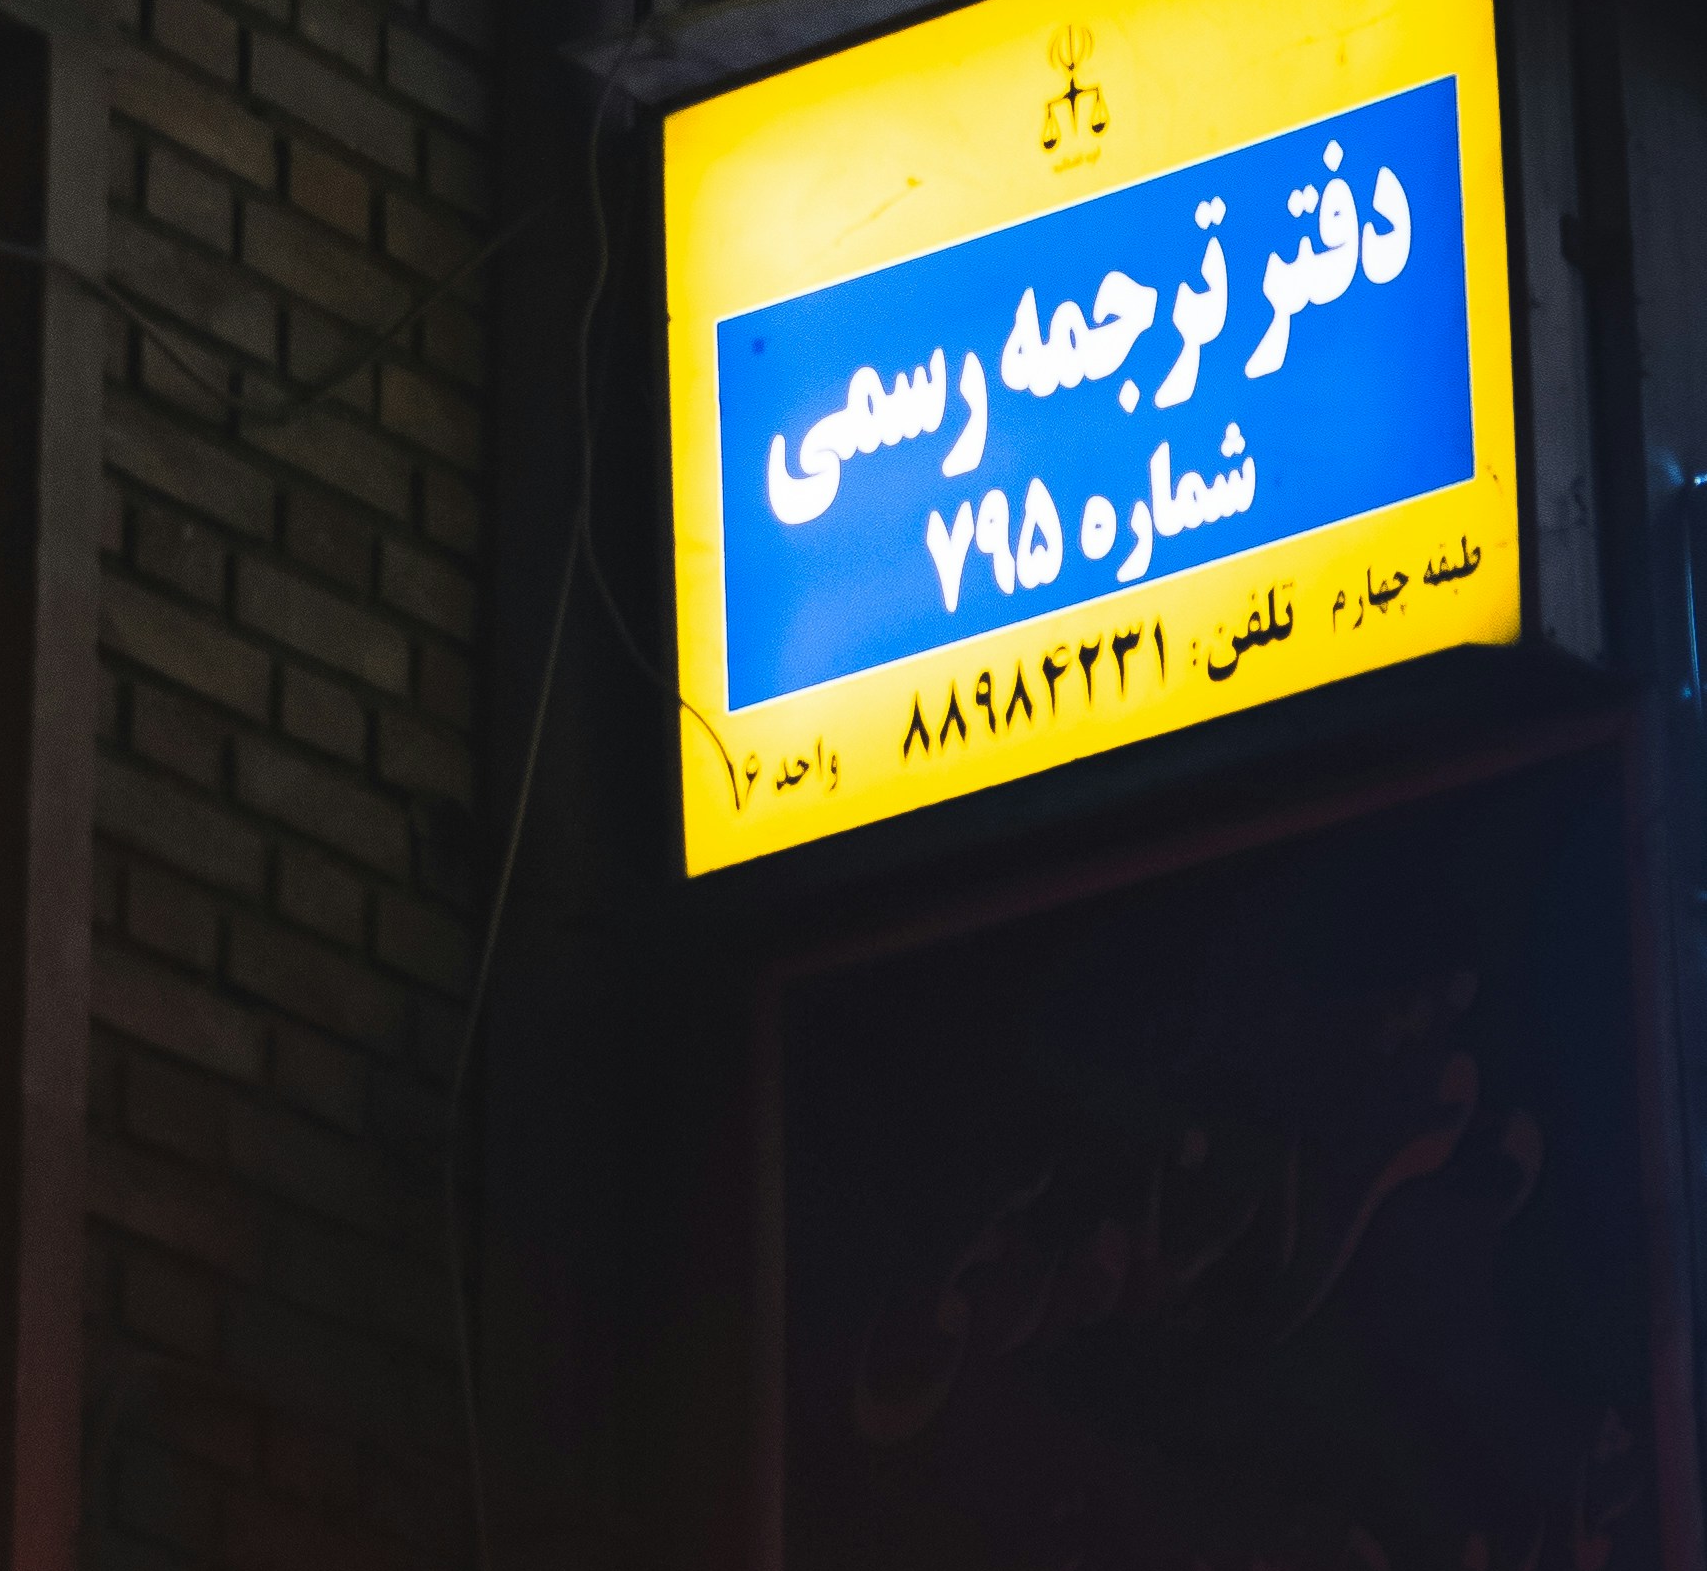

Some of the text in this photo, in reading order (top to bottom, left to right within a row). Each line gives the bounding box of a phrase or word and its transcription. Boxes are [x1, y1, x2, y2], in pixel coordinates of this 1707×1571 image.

[767, 140, 1412, 527] دفتر ترجمه رسمی
[925, 423, 1258, 613] شماره ۷۹۵
[1331, 534, 1483, 633] طبقه چهارم
[776, 735, 839, 793] واحد
[902, 617, 1166, 761] ۸۸۹۸۴۲۳۱
[1275, 968, 1544, 1347] دفتر
